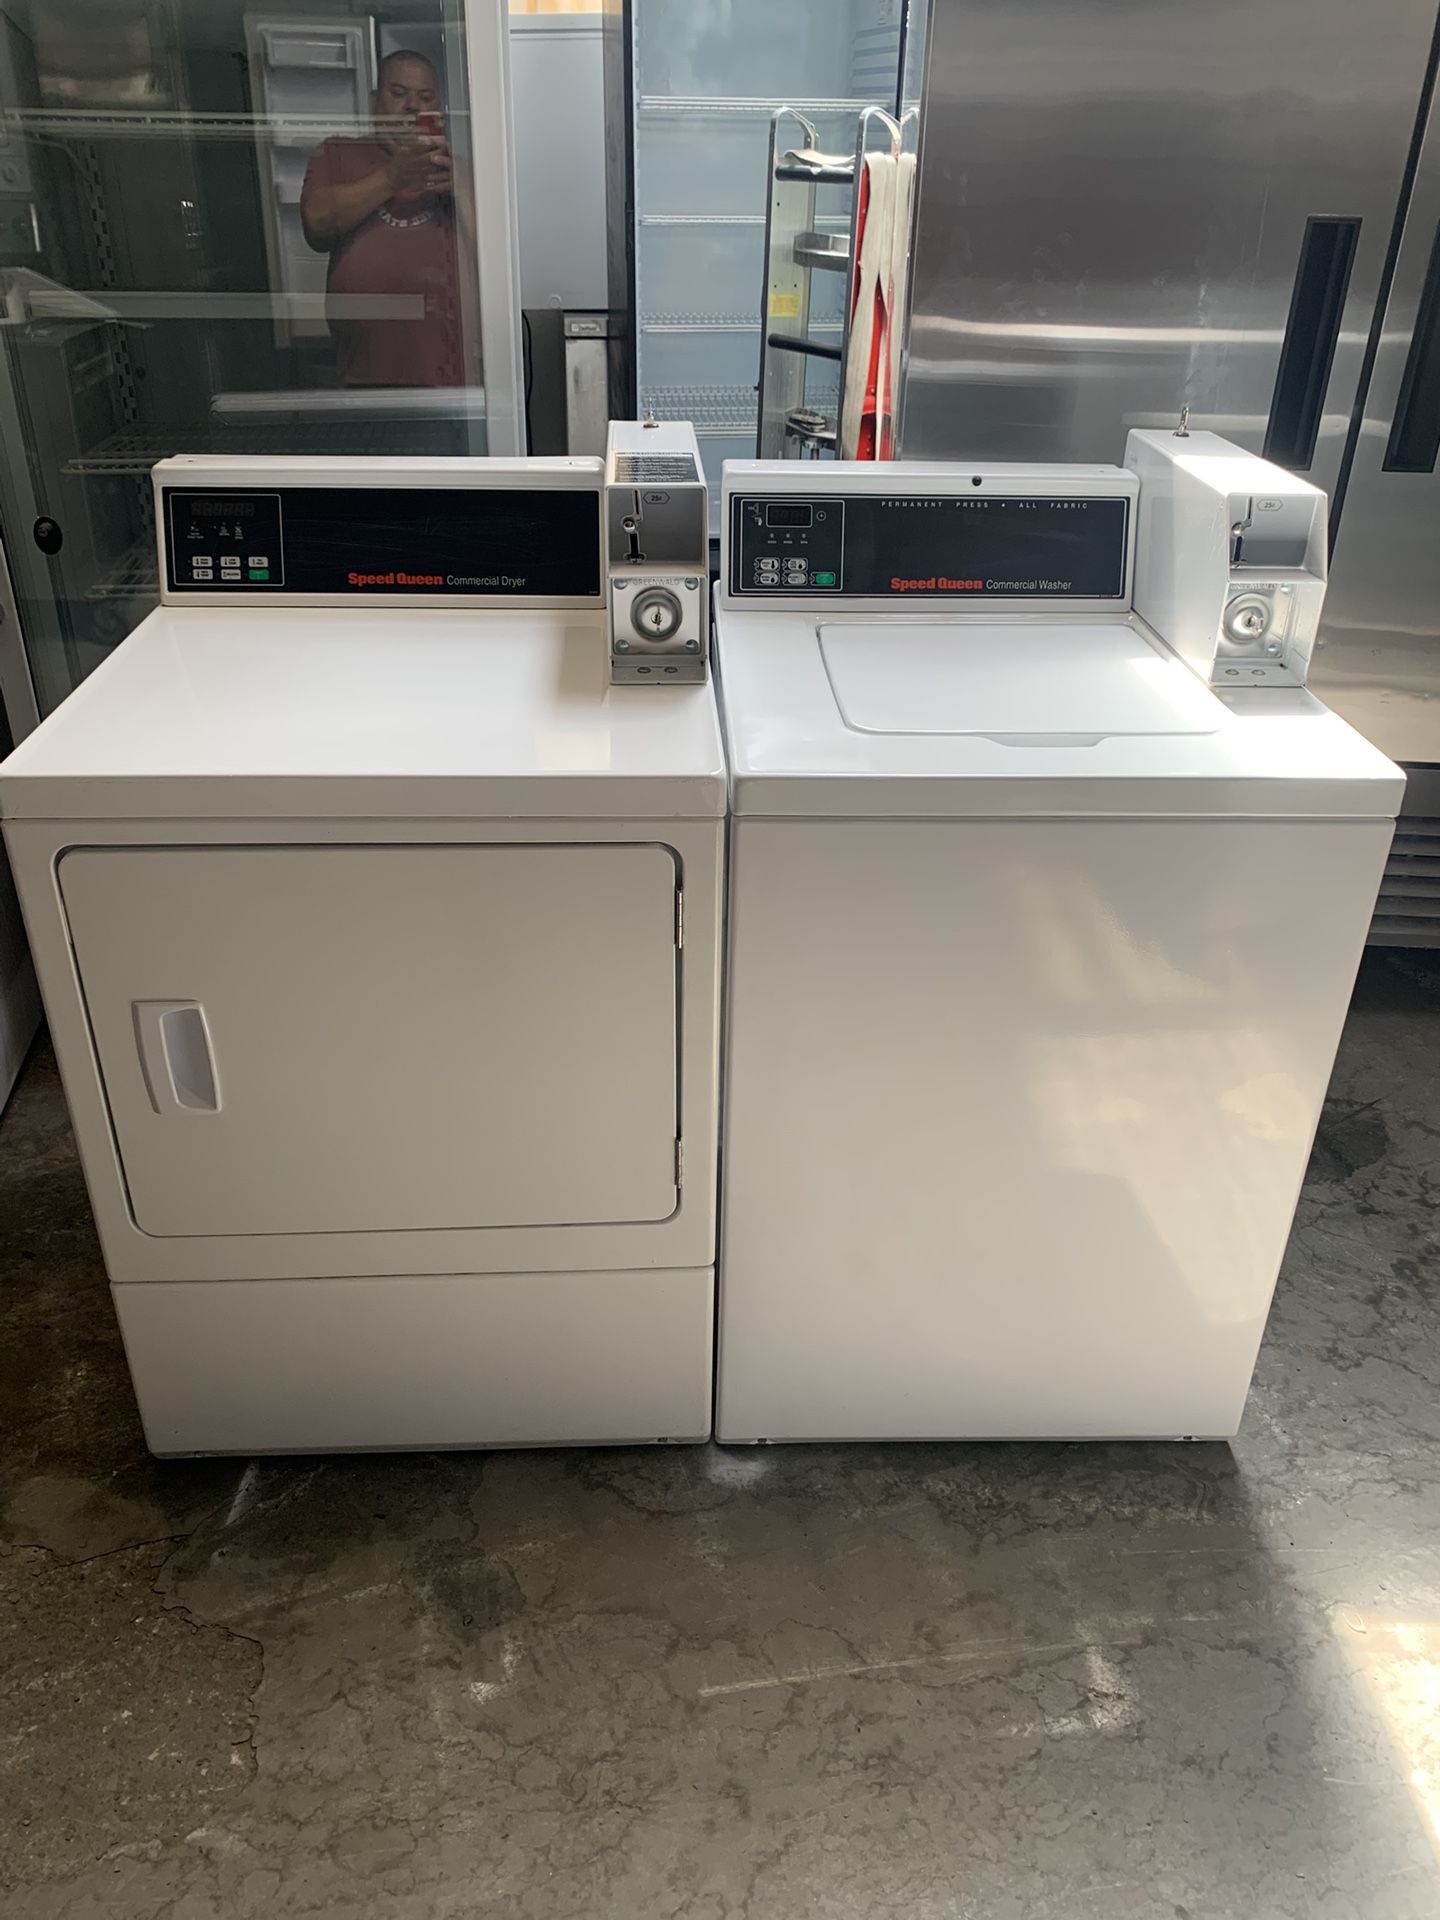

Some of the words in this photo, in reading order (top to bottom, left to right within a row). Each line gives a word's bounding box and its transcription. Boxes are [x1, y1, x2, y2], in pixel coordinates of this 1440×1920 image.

[347, 572, 395, 587] Speed
[396, 572, 443, 585] Queen
[446, 574, 500, 586] Commercial
[501, 575, 526, 588] Dryer
[890, 577, 935, 591] Speed
[937, 577, 983, 590] Queen
[986, 579, 1037, 590] Commercial
[1038, 579, 1072, 590] Washer
